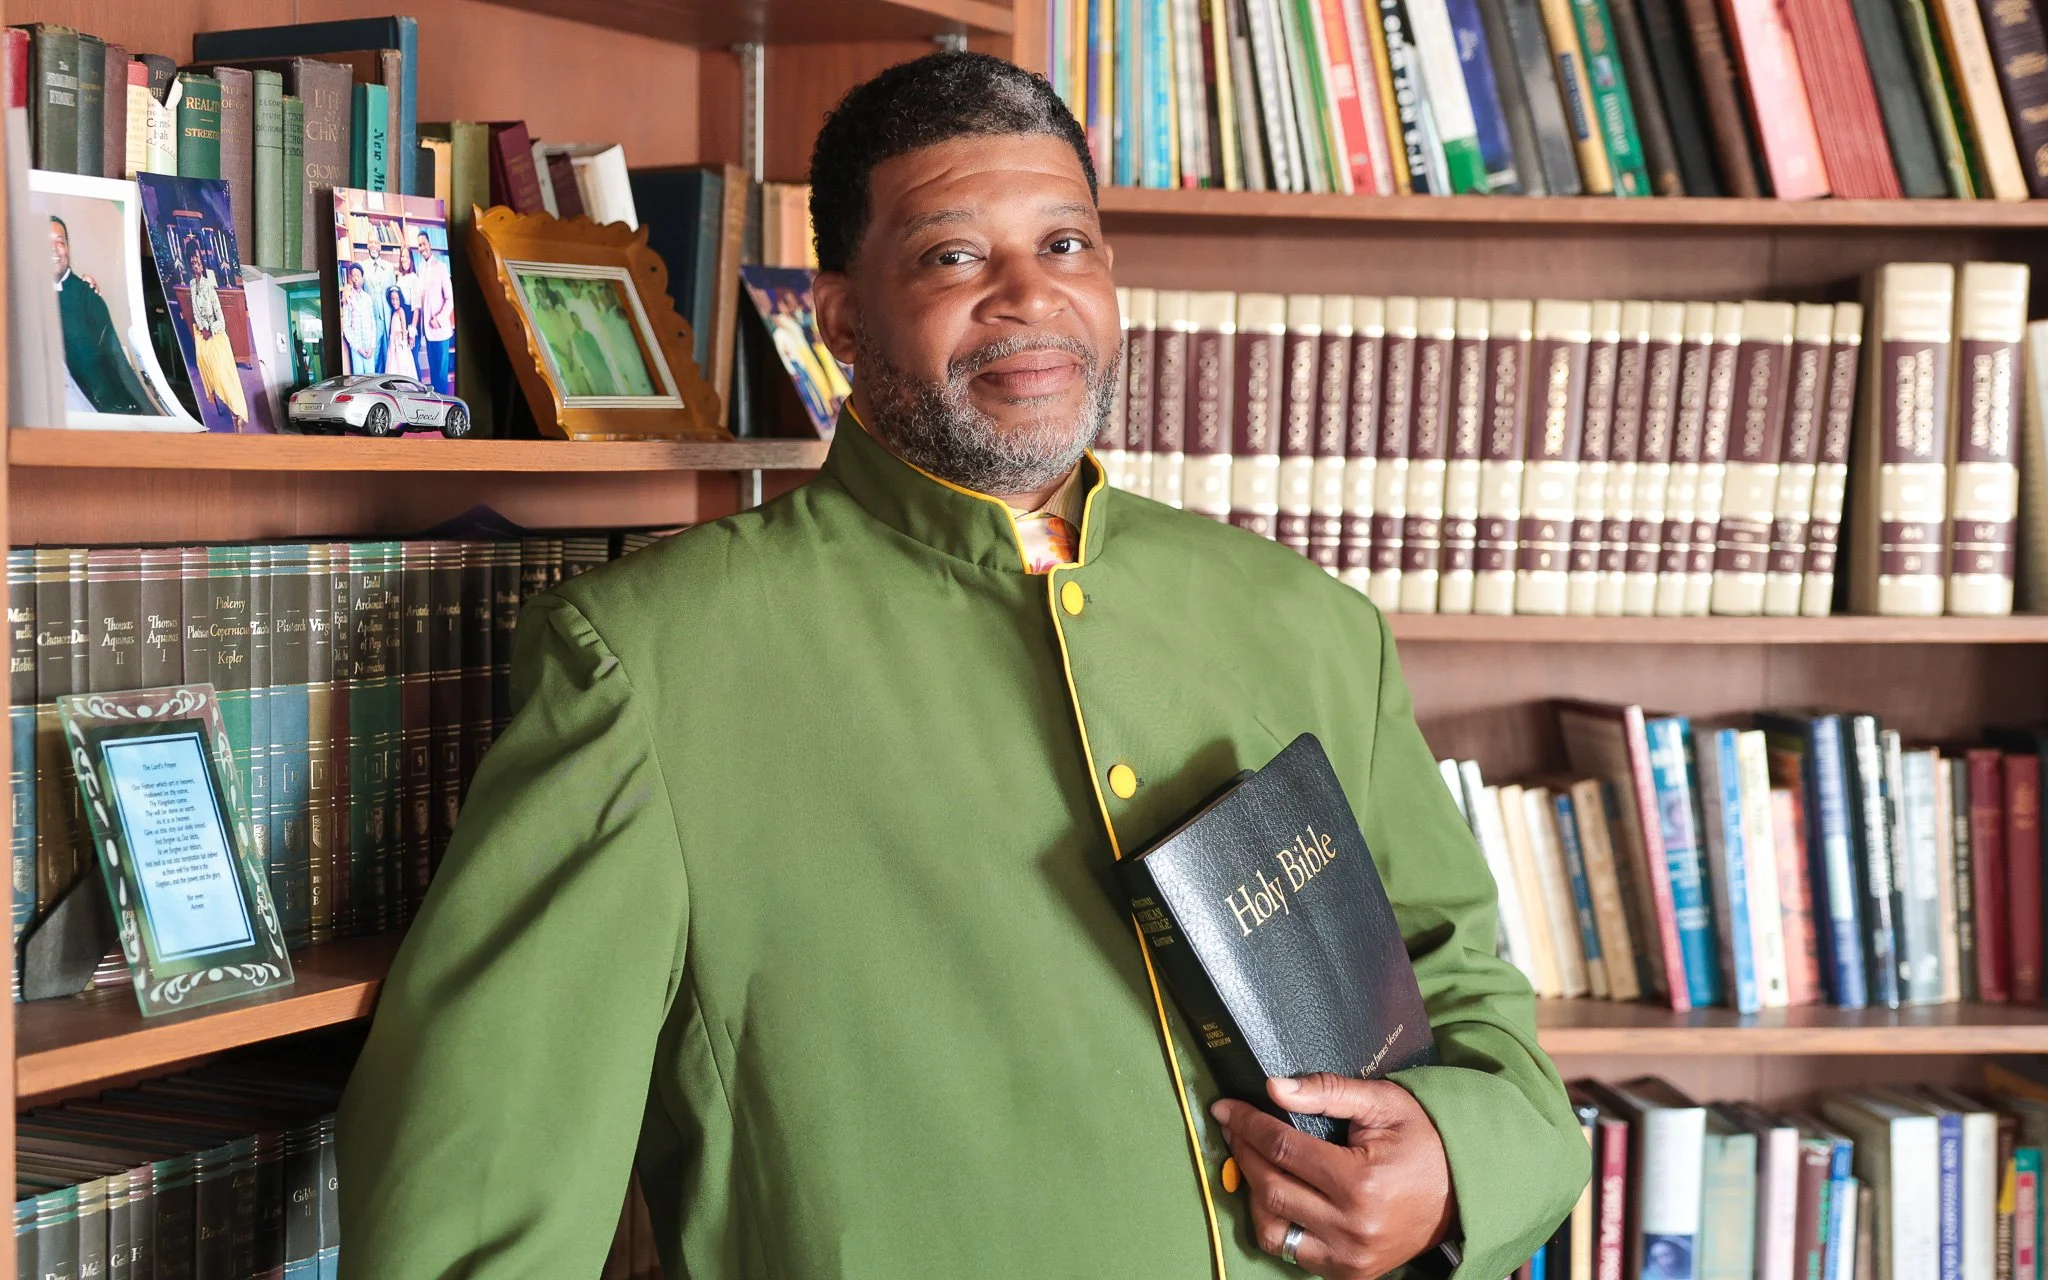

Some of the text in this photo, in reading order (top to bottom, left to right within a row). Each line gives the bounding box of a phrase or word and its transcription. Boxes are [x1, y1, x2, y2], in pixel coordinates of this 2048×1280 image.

[374, 129, 385, 162] New
[408, 409, 440, 424] Speed
[216, 595, 246, 613] Ptolemy
[102, 616, 134, 632] Thomas
[101, 632, 135, 652] Aquinas
[218, 649, 244, 670] Kepler
[1224, 824, 1336, 937] Holy Bible
[1361, 1023, 1404, 1080] King James Version
